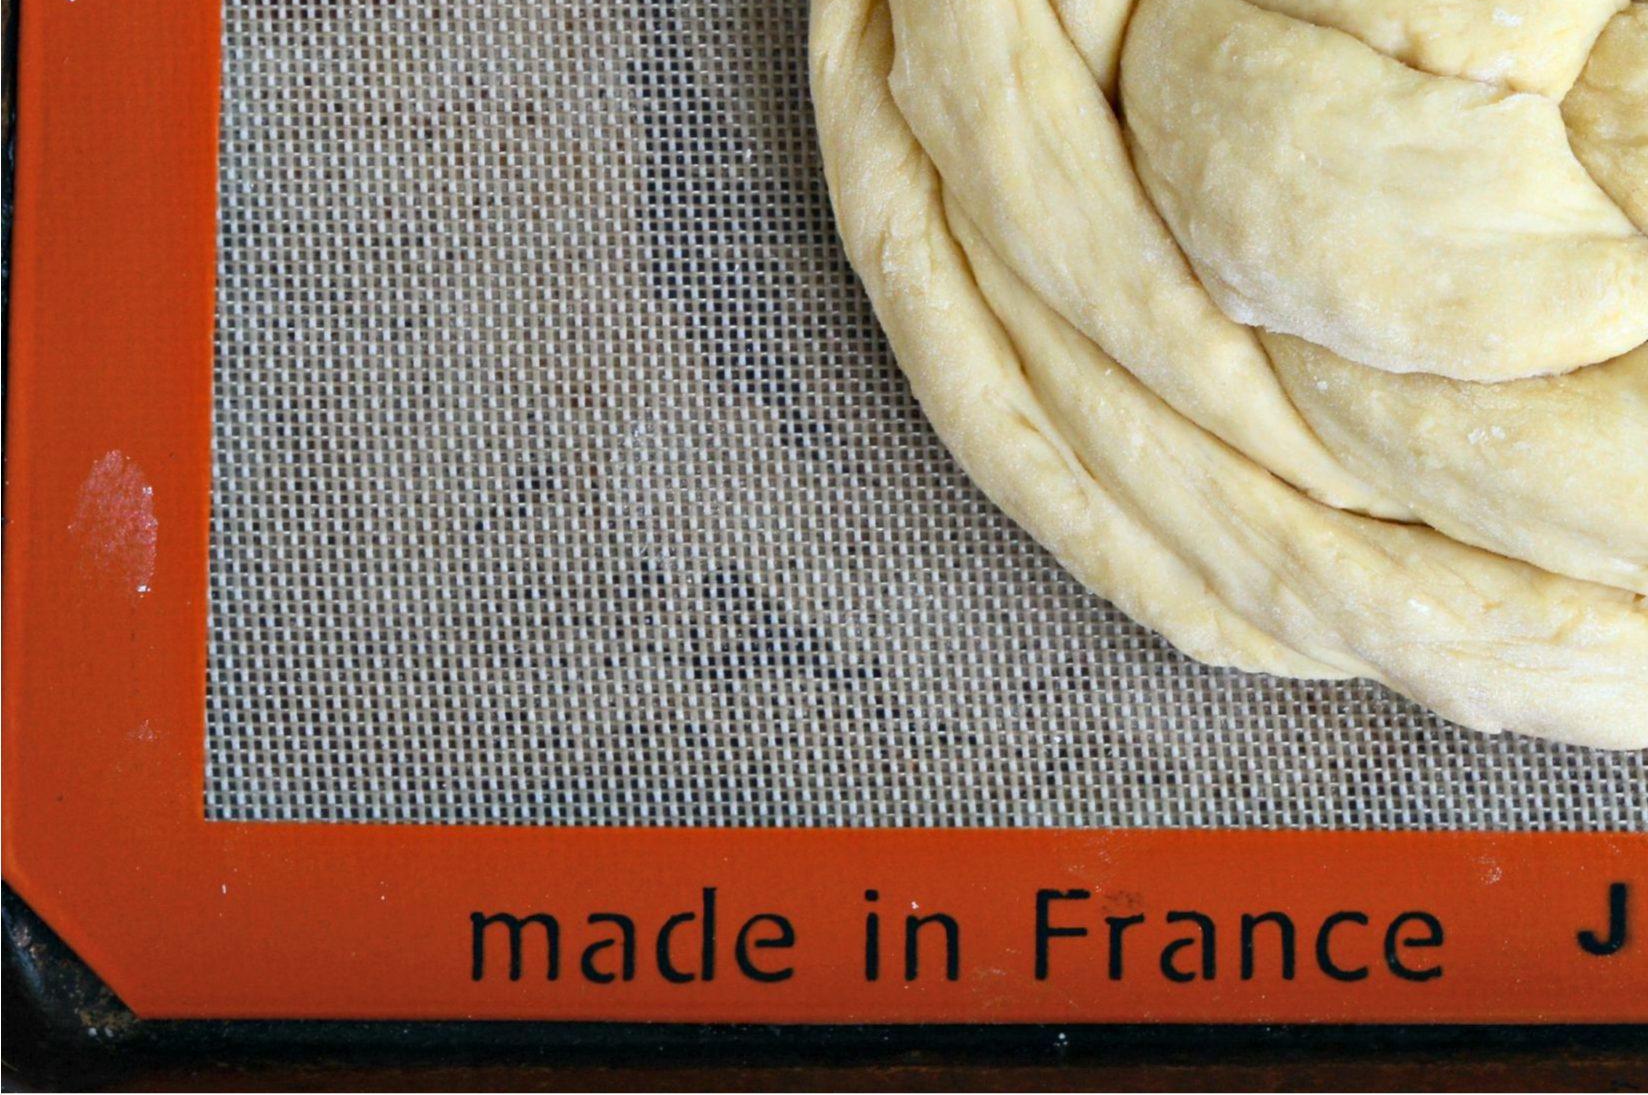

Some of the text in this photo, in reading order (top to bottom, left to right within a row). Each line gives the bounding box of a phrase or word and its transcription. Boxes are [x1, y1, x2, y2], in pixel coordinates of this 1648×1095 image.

[469, 887, 1446, 986] made in France
[1575, 882, 1632, 958] J
